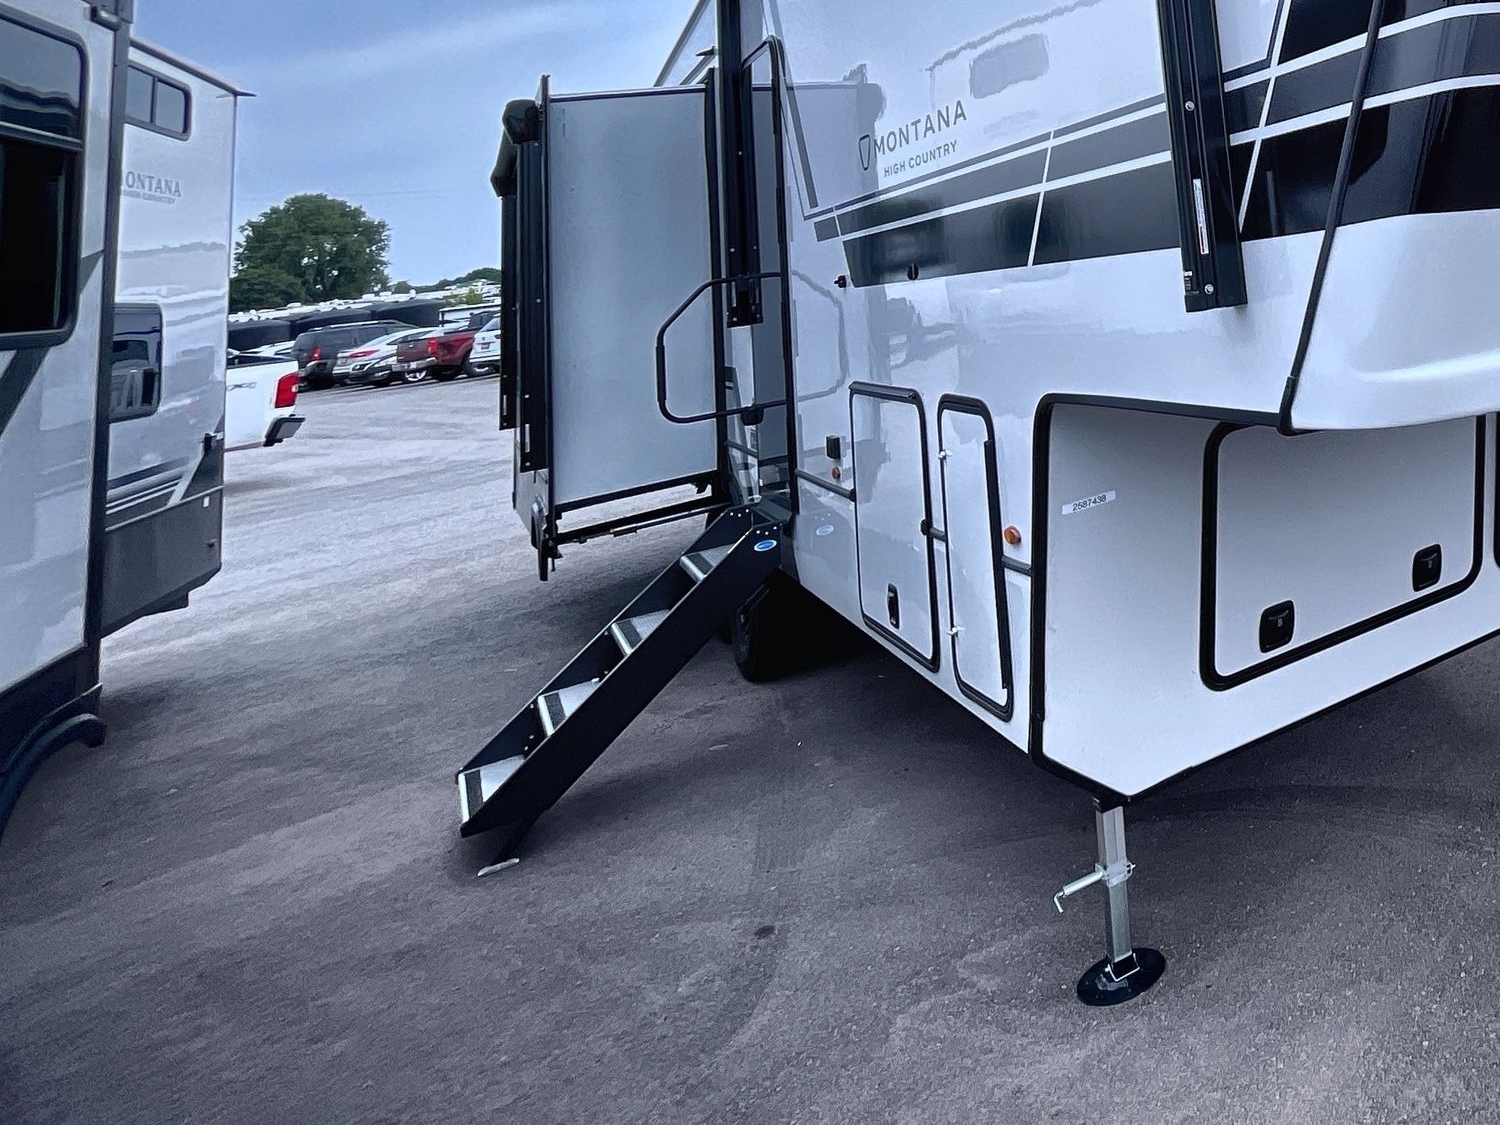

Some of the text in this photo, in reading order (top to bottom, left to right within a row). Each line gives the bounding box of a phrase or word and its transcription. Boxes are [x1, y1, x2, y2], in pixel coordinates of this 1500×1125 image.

[874, 100, 967, 158] MONTANA
[883, 140, 957, 177] HIGH COUNTRY
[125, 170, 182, 198] ONTANA
[1072, 495, 1106, 511] 2587438
